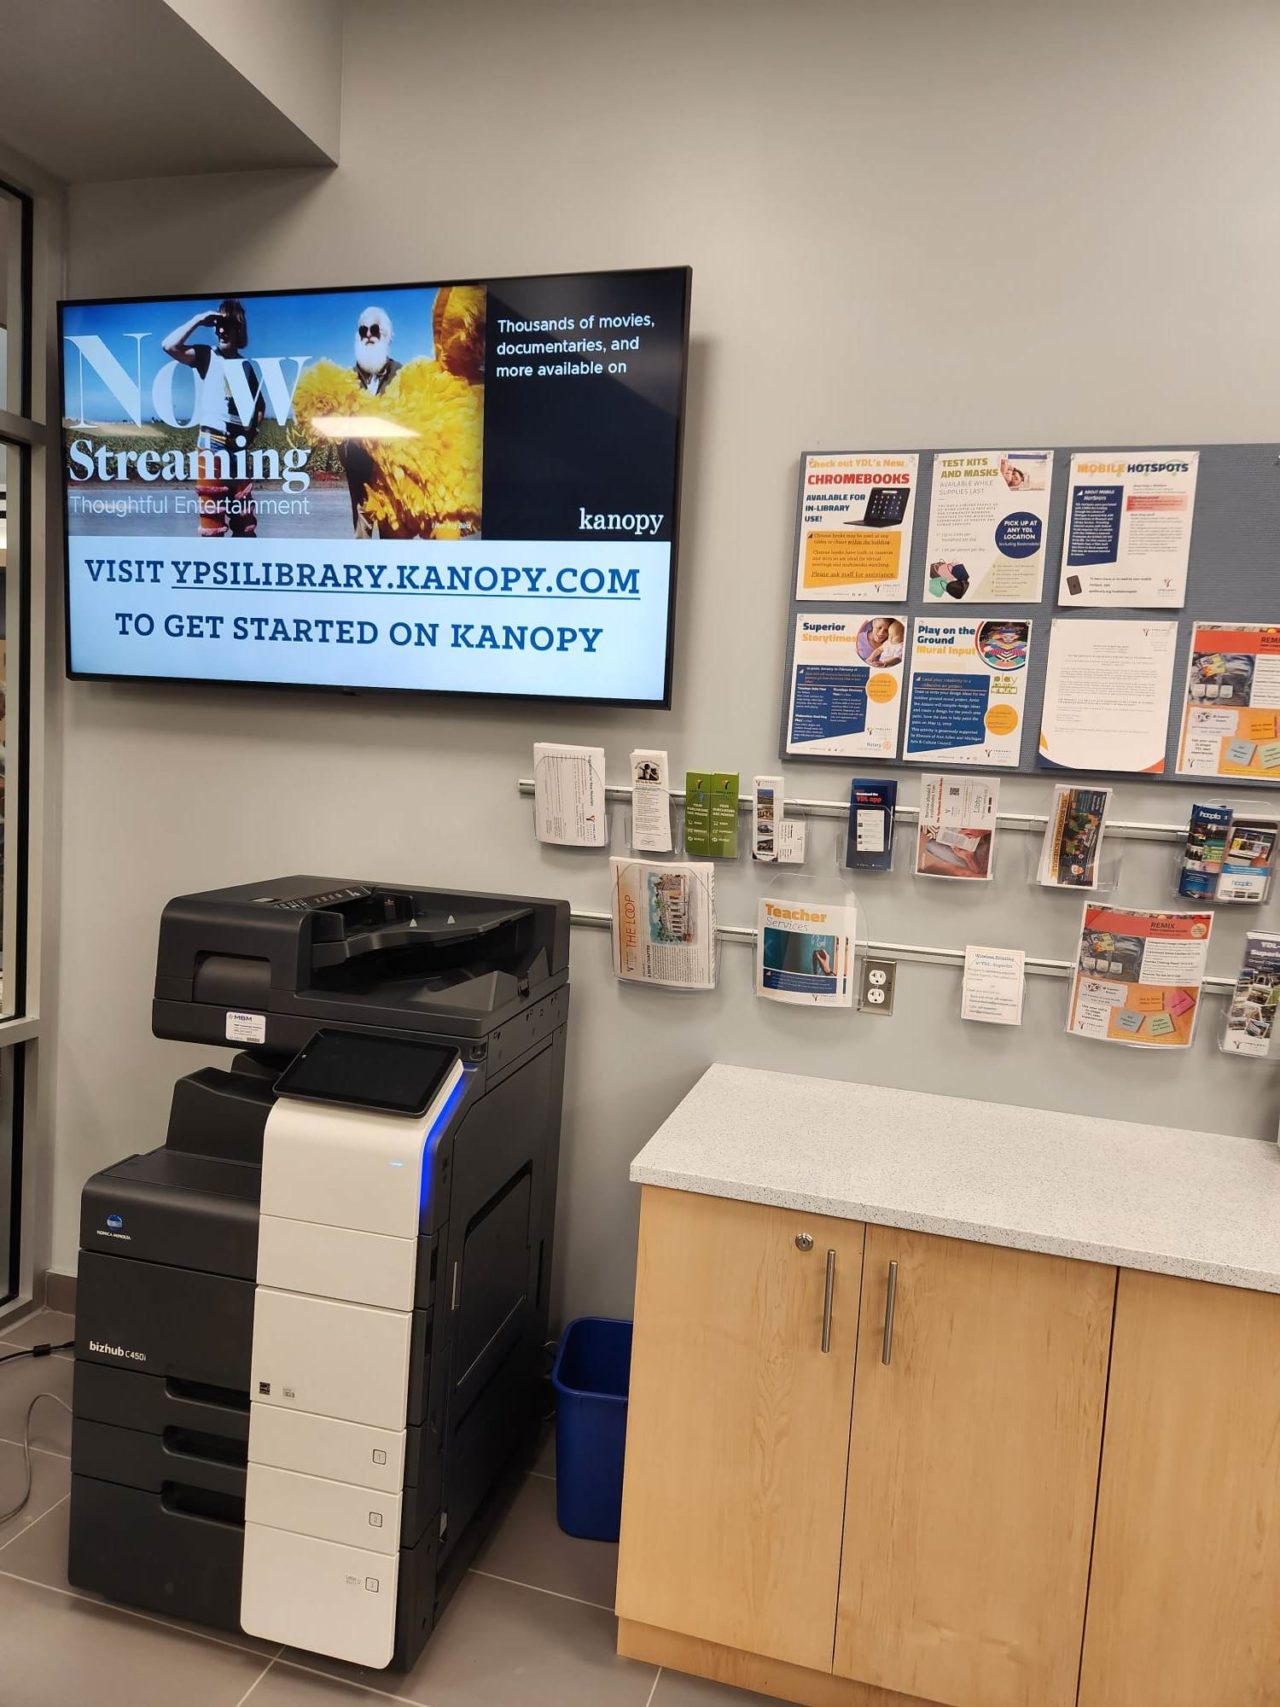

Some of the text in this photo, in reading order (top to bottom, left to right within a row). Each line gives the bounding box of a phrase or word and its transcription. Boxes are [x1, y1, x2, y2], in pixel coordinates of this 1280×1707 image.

[497, 313, 655, 333] Thousands of movies,
[496, 336, 640, 355] documentaries, and
[496, 361, 627, 377] more available on
[64, 331, 312, 429] Now
[69, 435, 311, 494] Streaming
[883, 459, 905, 467] New
[942, 458, 988, 467] TEST KITS
[1077, 463, 1188, 473] MOBILE HOTSPOTS
[807, 473, 910, 485] CHROMEBOOKS
[941, 468, 999, 478] AND MASKS
[940, 480, 972, 488] AVAILABLE
[70, 496, 310, 518] Thoughtful Entertainment
[578, 507, 664, 536] kanopy
[84, 559, 640, 594] VISIT YPSILIBRARY.KANOPY.COM
[115, 613, 603, 653] TO GET STARTED ON KANOPY
[803, 622, 845, 632] Superior
[918, 625, 940, 636] Play
[958, 626, 975, 635] the
[802, 633, 857, 644] Storytimes
[917, 636, 954, 644] Ground
[916, 645, 976, 657] Mural Input
[765, 903, 827, 922] Teacher
[624, 894, 636, 948] THE LOOP
[766, 916, 809, 932] Services
[1151, 921, 1175, 929] REMIX
[1250, 949, 1280, 958] Superi
[89, 1340, 124, 1356] bizhub
